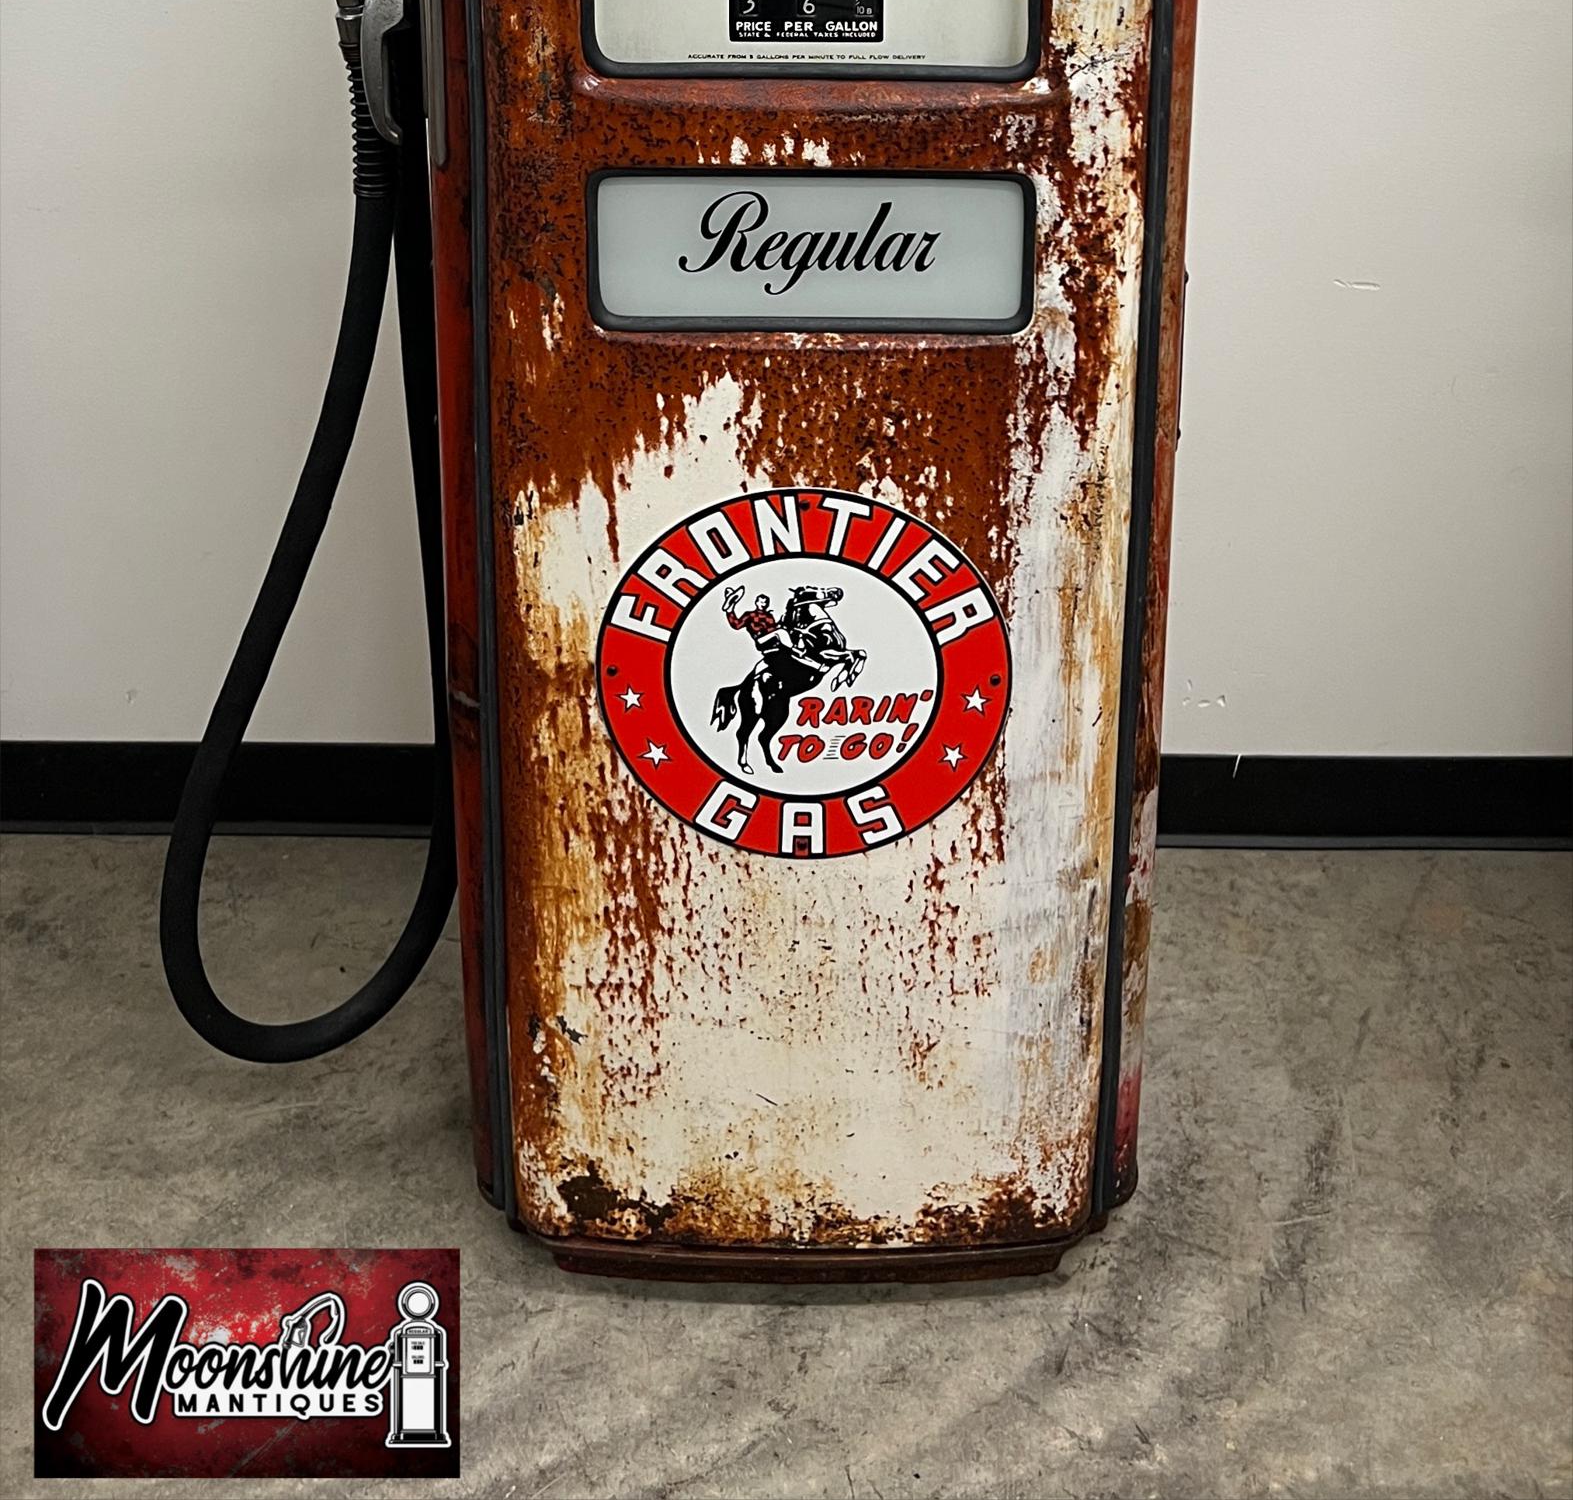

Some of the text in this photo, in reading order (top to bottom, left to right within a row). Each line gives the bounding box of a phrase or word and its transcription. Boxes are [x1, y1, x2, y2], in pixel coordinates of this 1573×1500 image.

[735, 20, 878, 32] PRICE PER GALLON
[678, 190, 942, 296] Regular
[610, 495, 994, 646] FRONTIER
[796, 689, 934, 728] RARIN'
[778, 722, 919, 763] TO GO!
[695, 780, 903, 854] GAS
